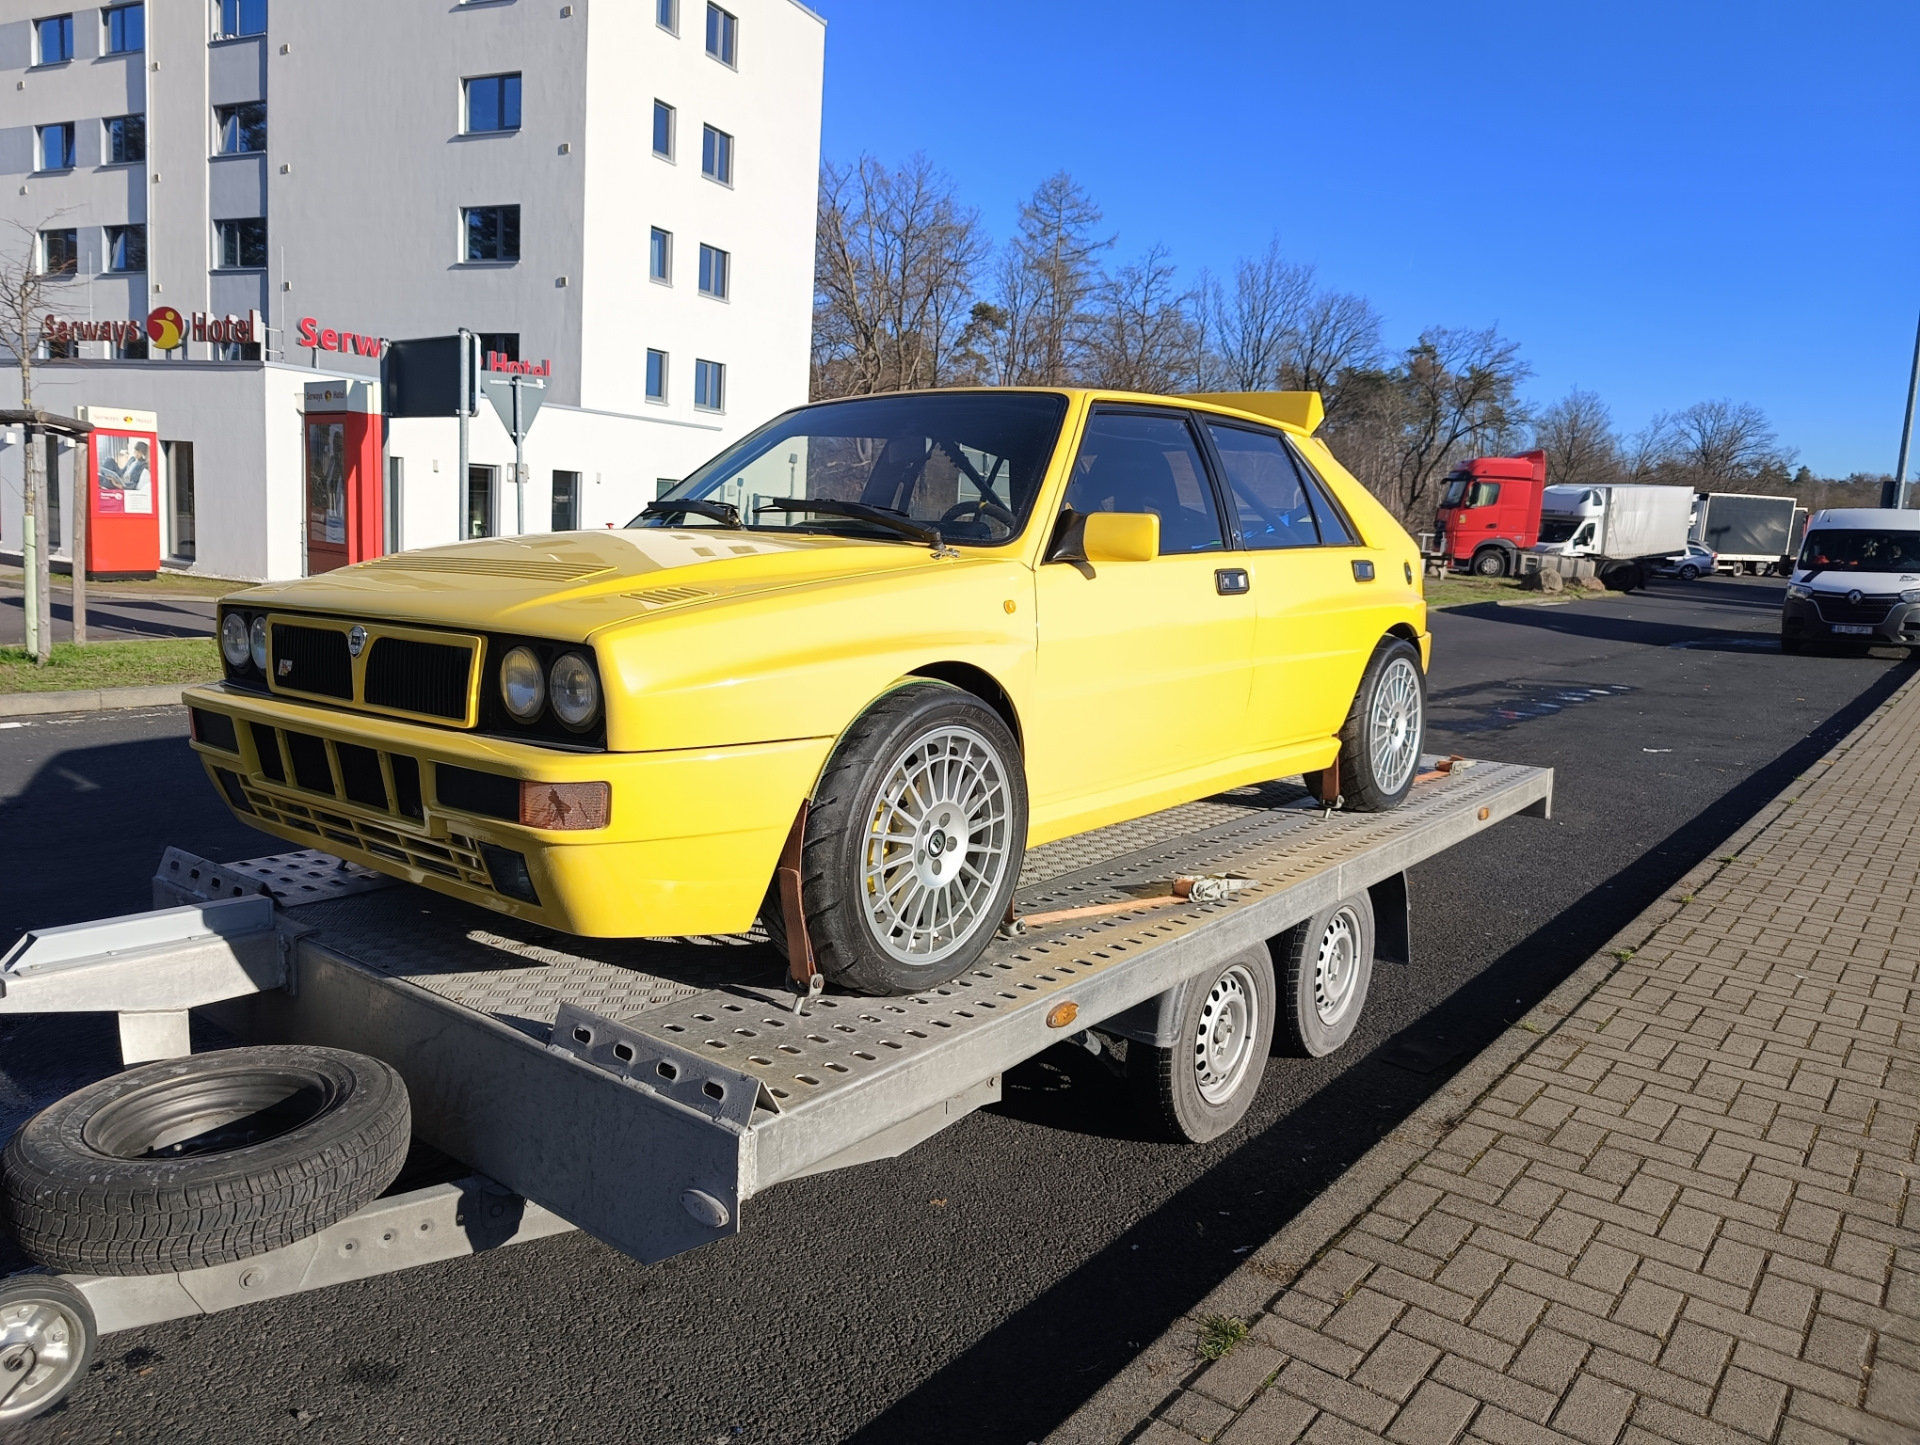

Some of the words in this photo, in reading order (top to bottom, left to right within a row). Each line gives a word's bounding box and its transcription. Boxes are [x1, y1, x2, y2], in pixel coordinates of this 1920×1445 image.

[45, 314, 139, 349] Serways
[192, 309, 254, 342] Hotel
[298, 316, 382, 358] Serw
